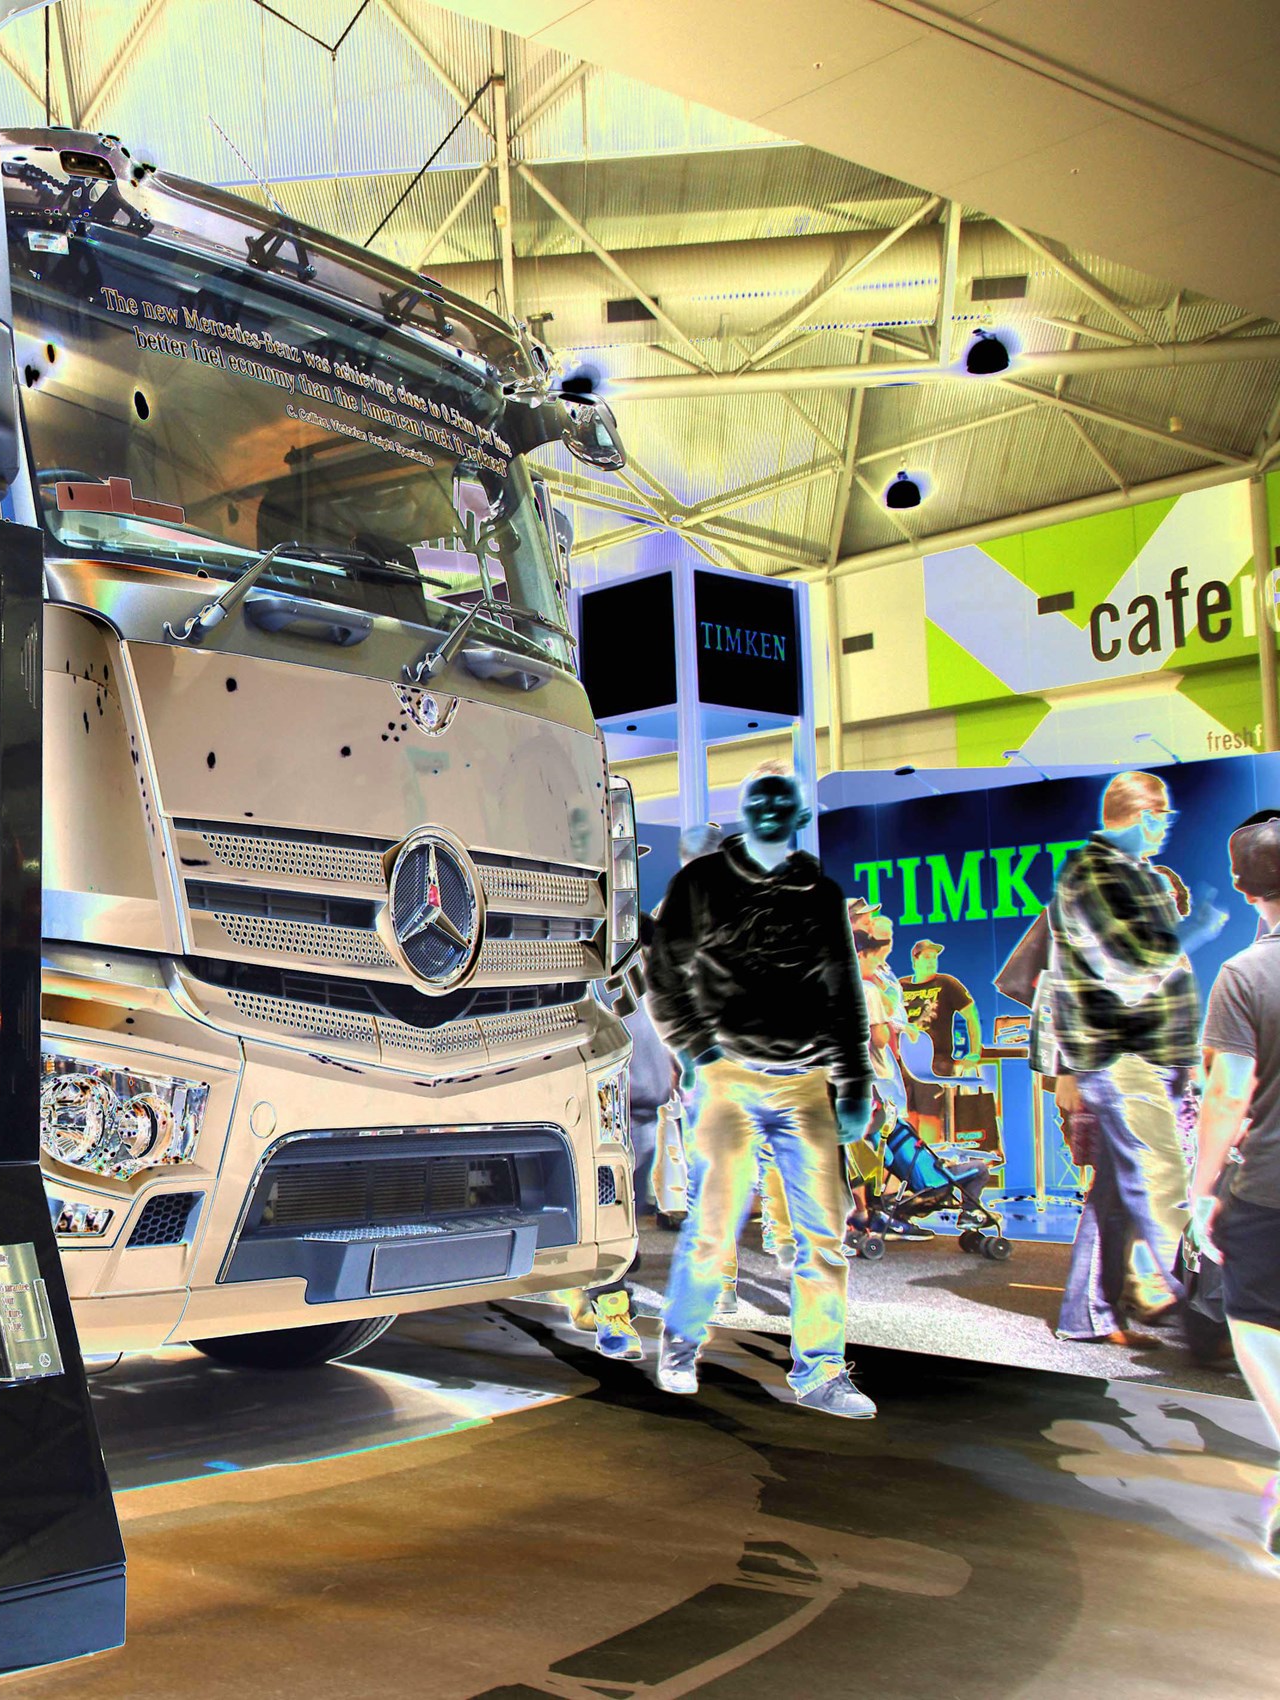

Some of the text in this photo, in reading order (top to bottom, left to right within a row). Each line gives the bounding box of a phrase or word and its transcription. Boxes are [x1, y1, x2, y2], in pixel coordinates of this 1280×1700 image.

[101, 287, 138, 315] The
[142, 301, 178, 325] new
[182, 306, 301, 364] Mercedes-Benz
[302, 350, 331, 374] was
[333, 361, 397, 404] achieving
[397, 384, 428, 413] close
[428, 398, 441, 419] to
[133, 325, 188, 359] better
[191, 339, 227, 369] fuel
[228, 354, 295, 395] economy
[297, 373, 333, 403] than
[333, 386, 359, 412] the
[361, 395, 422, 437] American
[421, 420, 454, 451] truck
[452, 433, 465, 456] it
[701, 621, 786, 661] TIMKEN
